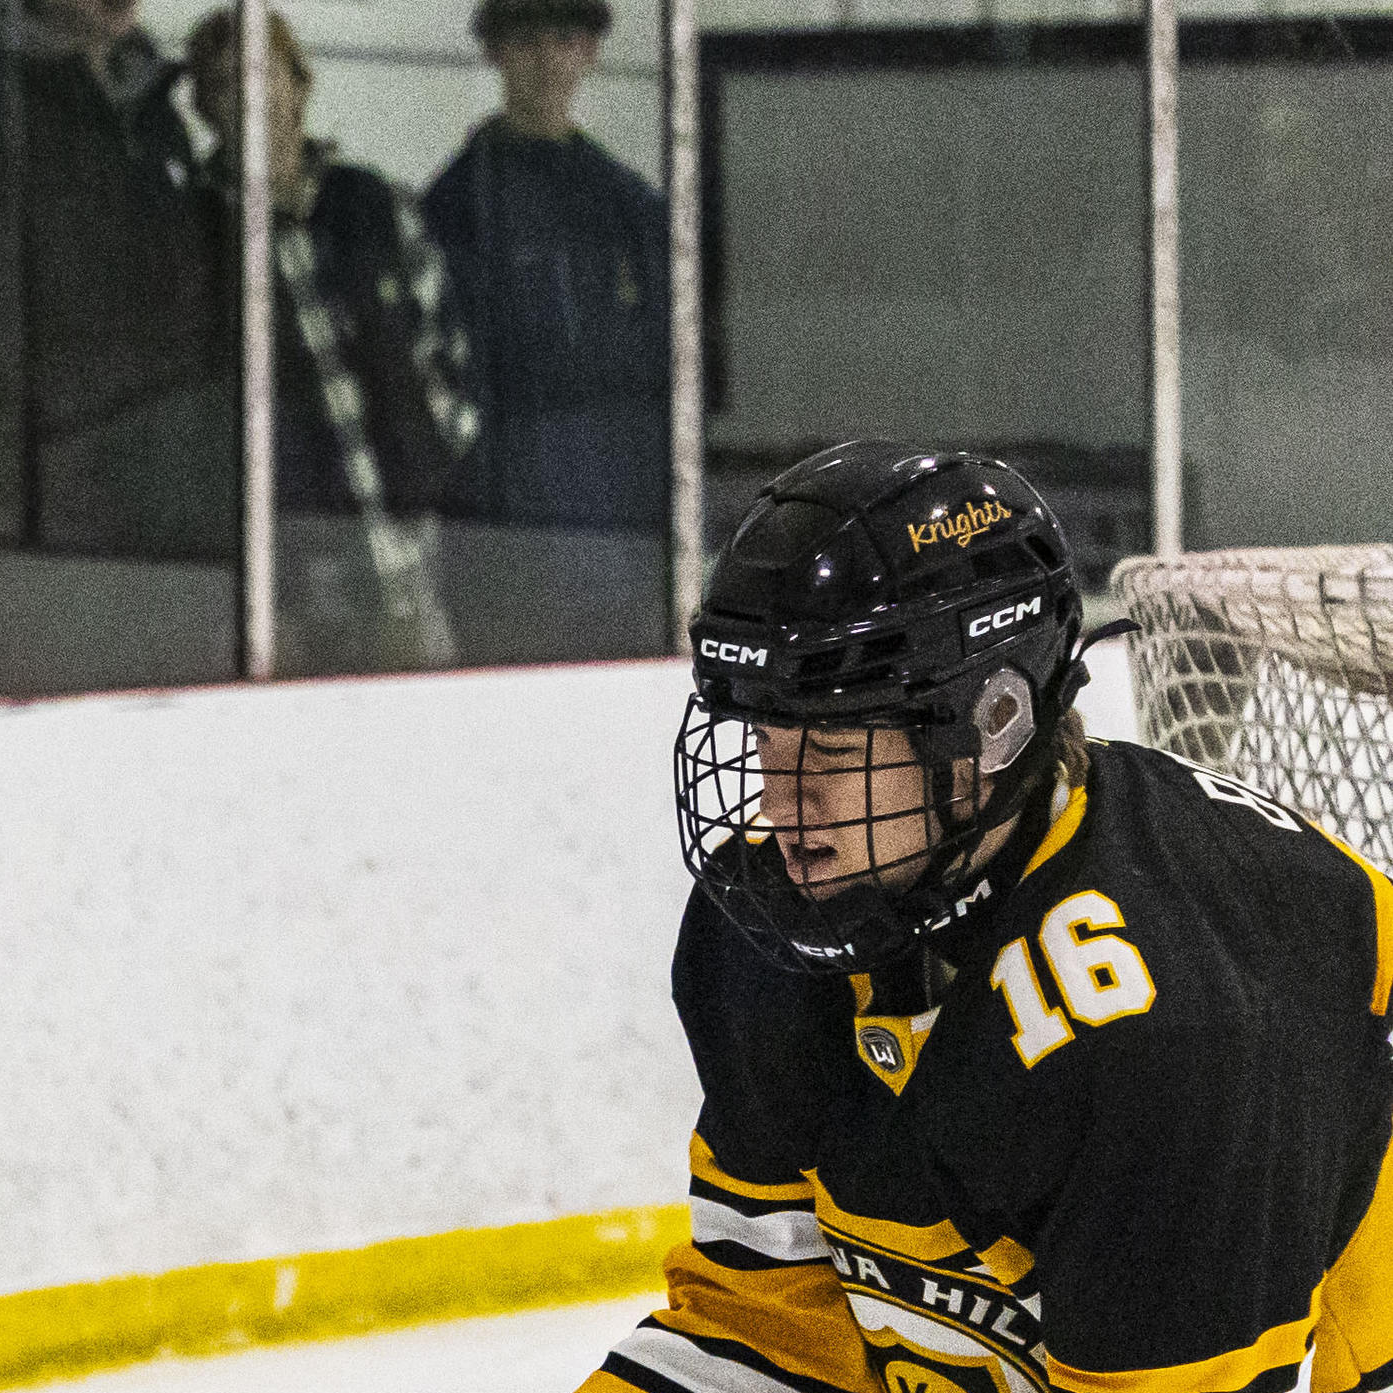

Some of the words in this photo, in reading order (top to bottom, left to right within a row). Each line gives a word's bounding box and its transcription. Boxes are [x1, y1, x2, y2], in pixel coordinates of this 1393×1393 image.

[907, 500, 1012, 553] Knights
[968, 596, 1042, 638] CCM
[700, 637, 768, 667] CCM
[990, 889, 1157, 1069] 16
